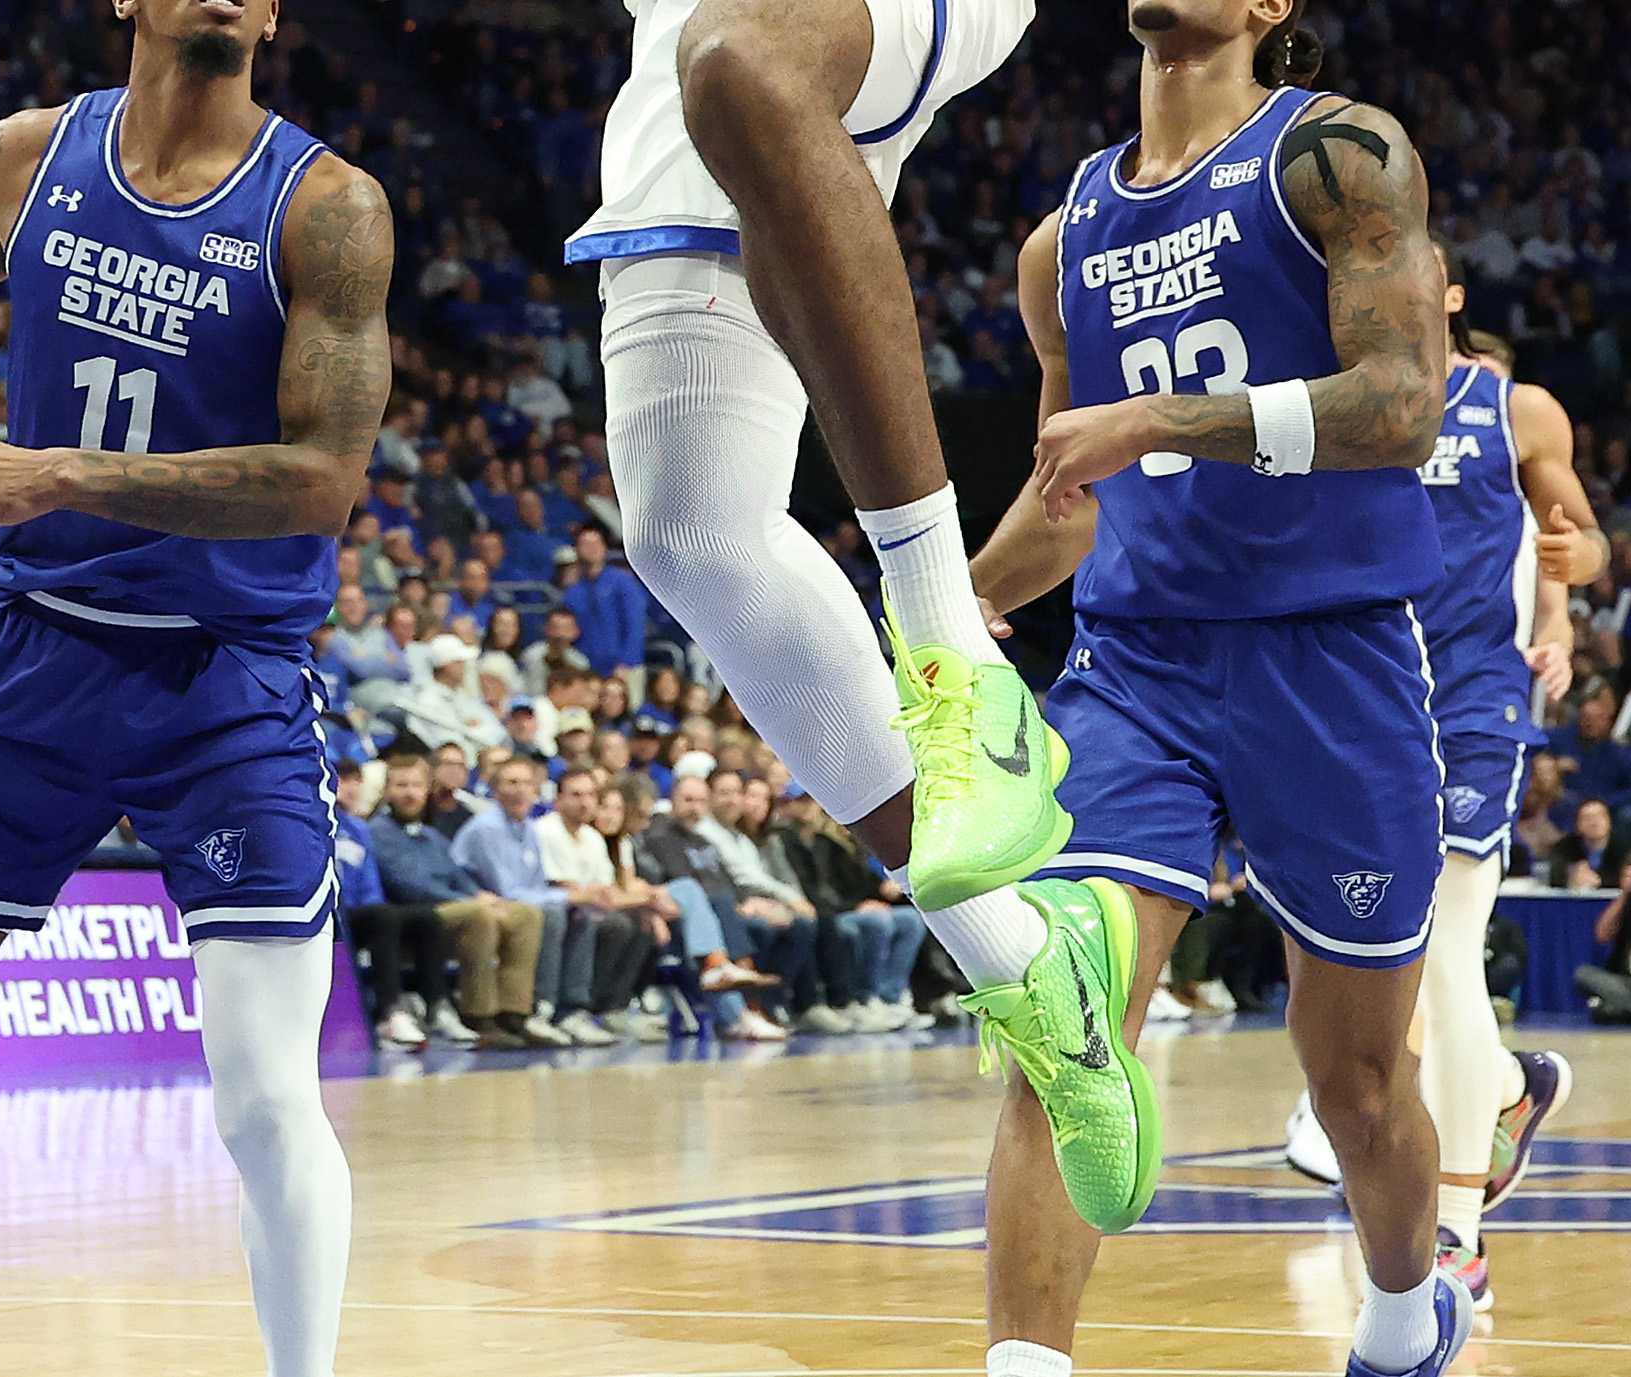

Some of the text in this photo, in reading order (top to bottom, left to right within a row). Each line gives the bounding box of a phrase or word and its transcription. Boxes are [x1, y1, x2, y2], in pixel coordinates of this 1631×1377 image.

[43, 229, 230, 316] GEORGIA
[1081, 209, 1242, 290] GEORGIA
[1110, 250, 1221, 318] STATE
[61, 276, 195, 345] STATE
[73, 356, 158, 455] 11
